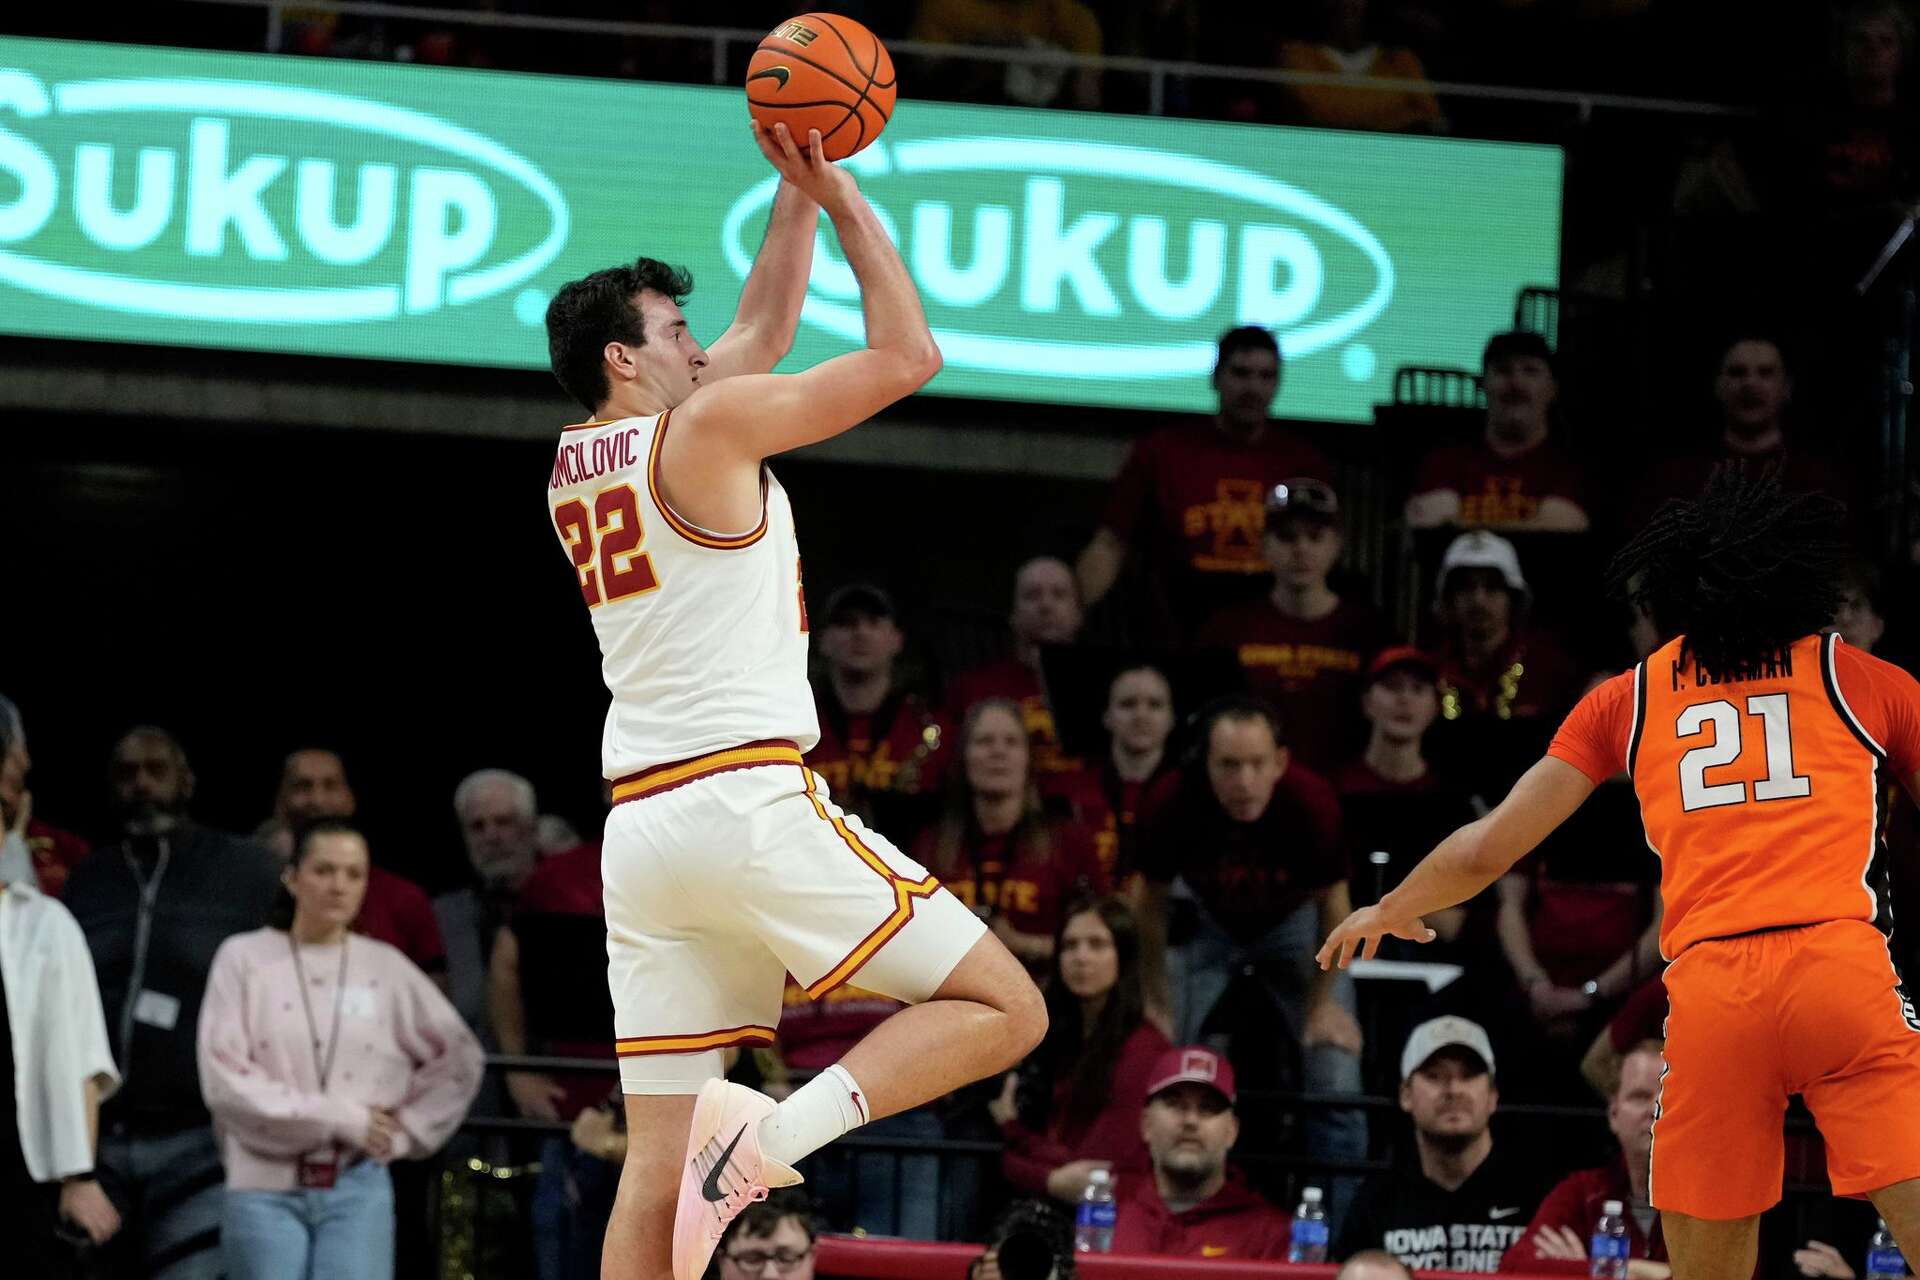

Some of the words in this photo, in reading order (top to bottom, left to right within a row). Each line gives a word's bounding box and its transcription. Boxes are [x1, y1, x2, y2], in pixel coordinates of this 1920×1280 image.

[551, 428, 639, 489] MCILOVIC
[555, 483, 661, 608] 22
[1676, 692, 1812, 813] 21
[1384, 1224, 1447, 1254] IOWA
[1399, 1250, 1503, 1274] YCLONE
